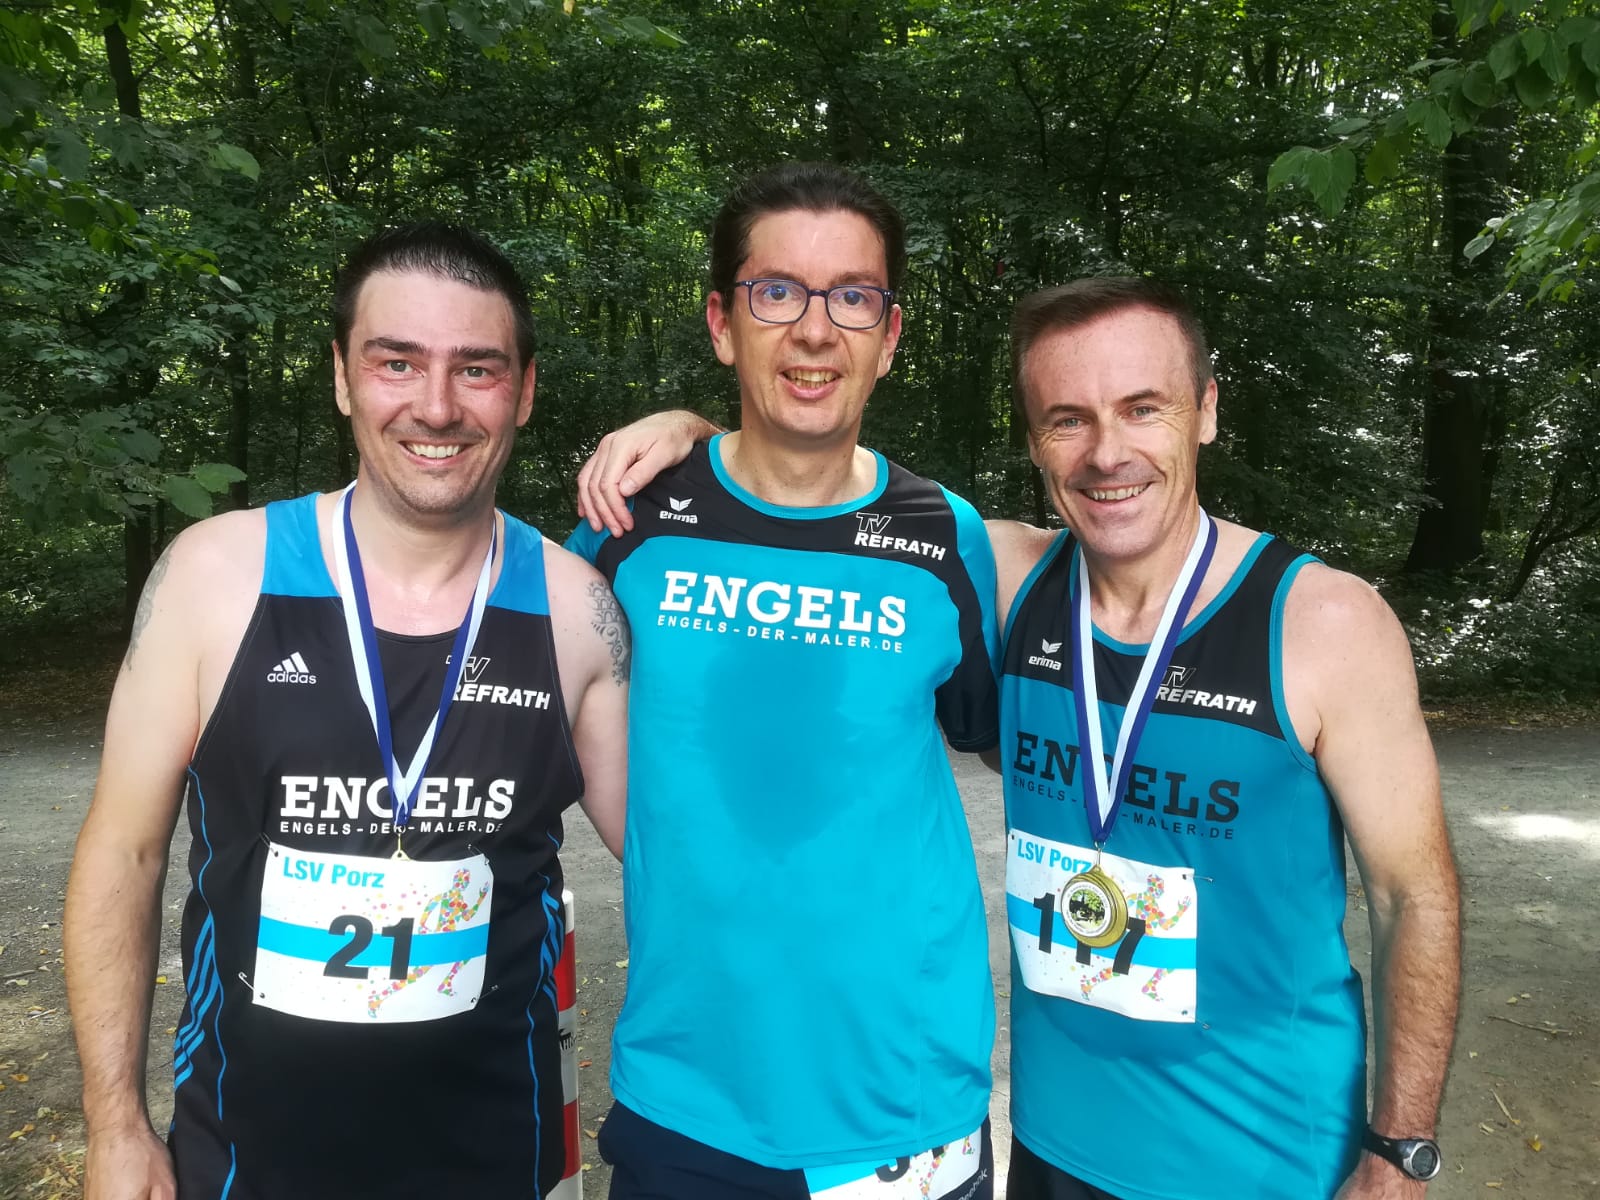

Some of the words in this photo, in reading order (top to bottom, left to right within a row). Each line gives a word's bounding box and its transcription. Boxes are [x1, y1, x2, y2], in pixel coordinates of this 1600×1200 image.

[659, 510, 698, 524] erima
[855, 512, 892, 535] TV
[854, 532, 946, 561] REFRATH
[659, 570, 906, 637] ENGELS
[1028, 655, 1062, 671] erima
[267, 671, 317, 685] adidas
[1155, 686, 1257, 715] REFRATH
[1014, 731, 1241, 823] ENELS
[1017, 838, 1045, 864] LSV
[1049, 849, 1092, 874] Porz
[283, 856, 325, 882] LSV
[331, 863, 385, 888] Porz
[323, 914, 415, 980] 21
